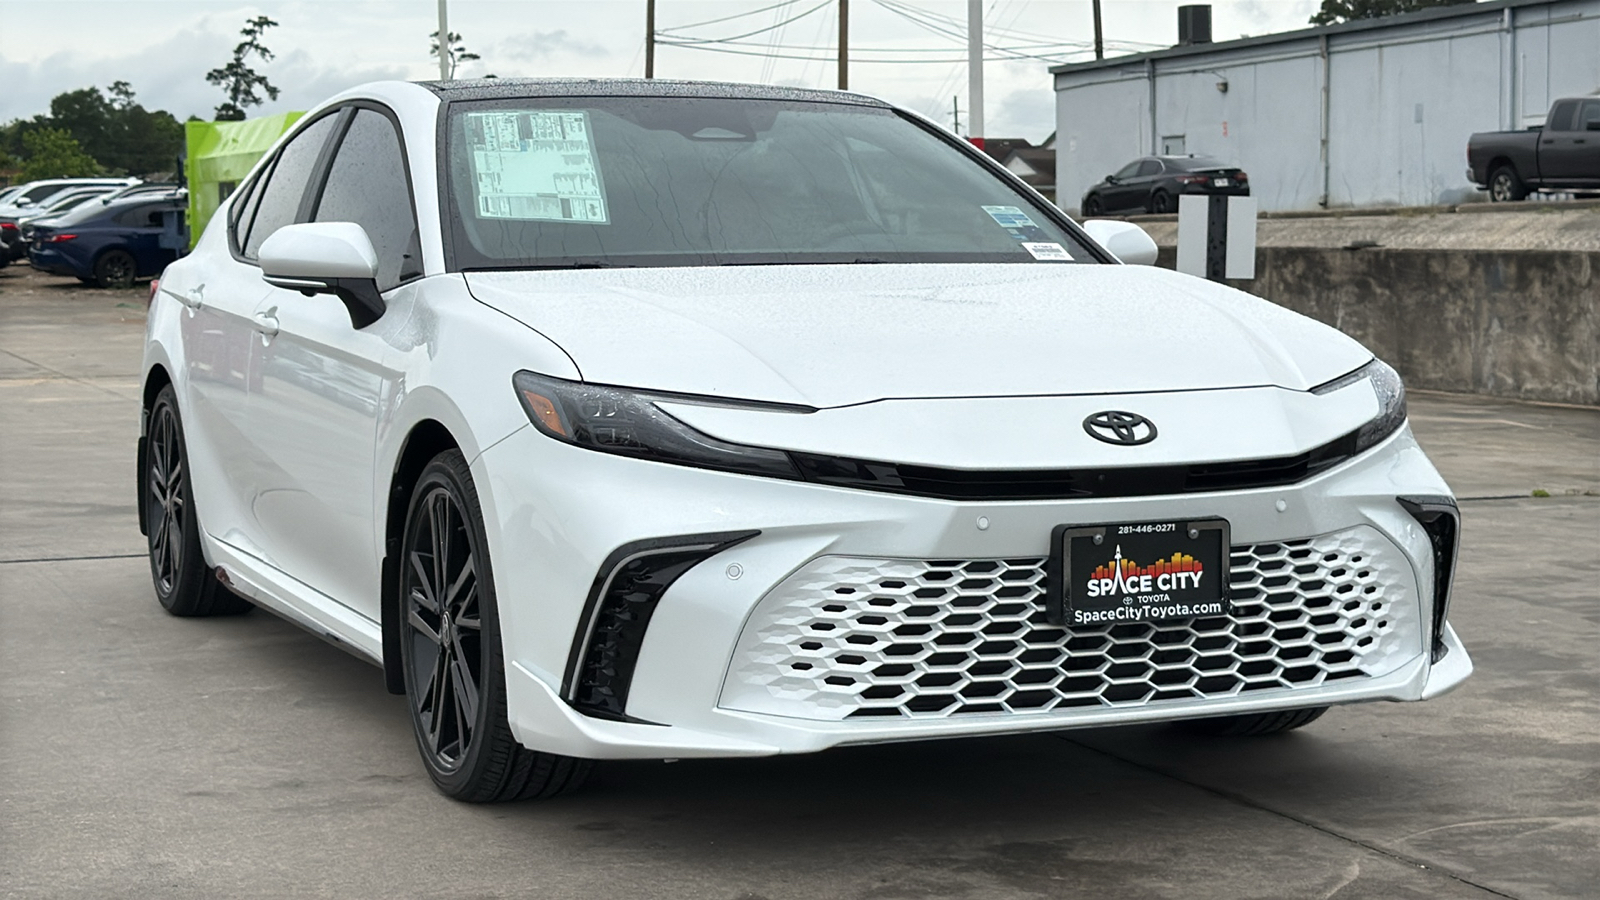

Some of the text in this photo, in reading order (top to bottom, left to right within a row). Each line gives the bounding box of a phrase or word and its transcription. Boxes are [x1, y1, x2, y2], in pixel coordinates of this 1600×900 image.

[1118, 524, 1175, 534] 281-446-0271
[1087, 571, 1203, 597] SPACE CITY
[1137, 594, 1170, 603] TOYOTA
[1074, 602, 1222, 624] SpaceCityToyota.com
